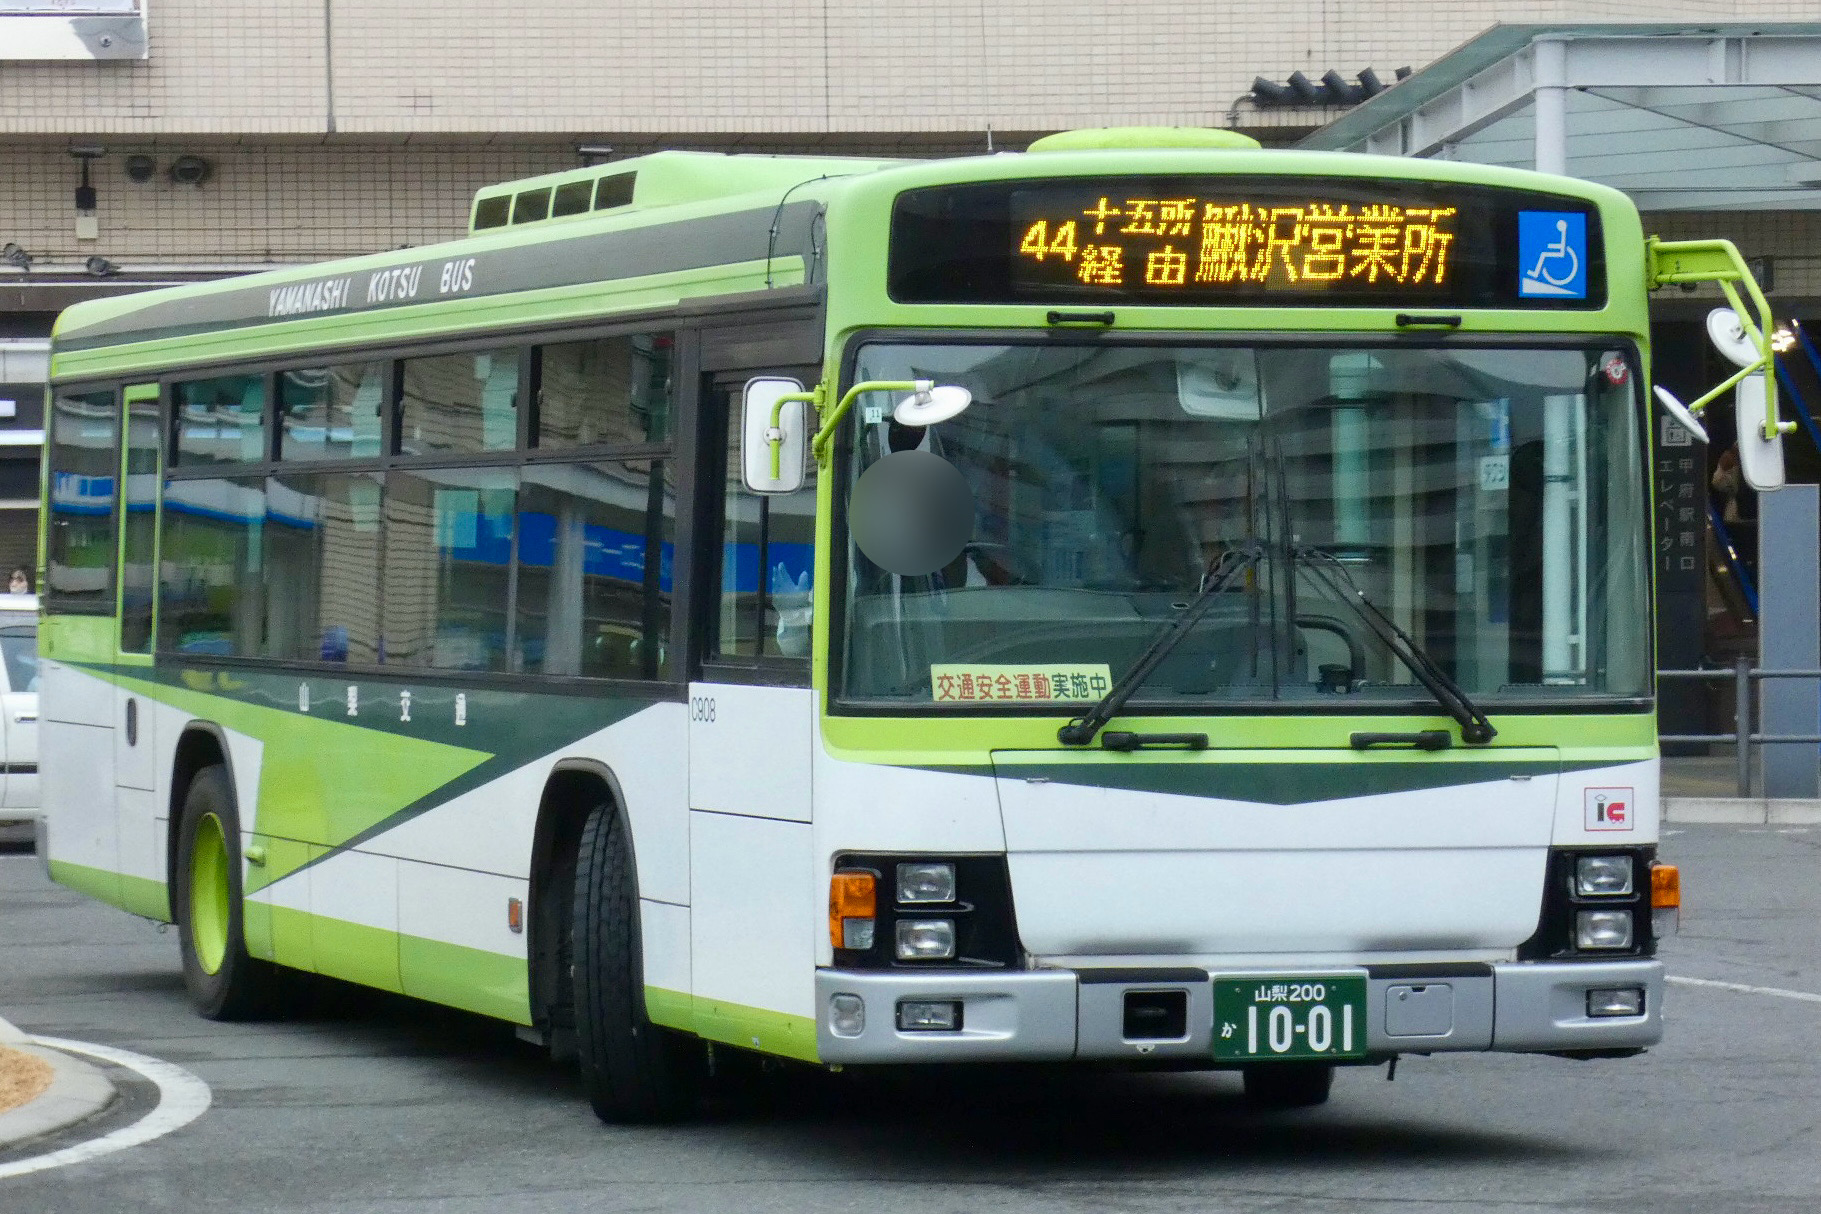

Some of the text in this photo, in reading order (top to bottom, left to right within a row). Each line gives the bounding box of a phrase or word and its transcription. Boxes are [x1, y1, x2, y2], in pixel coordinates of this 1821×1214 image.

[1083, 197, 1197, 236] 十五所
[1020, 220, 1078, 262] 44
[1195, 203, 1458, 283] 鰍沢営業所
[1077, 244, 1187, 285] 経由
[268, 258, 476, 317] YAMANASHI KOTSU BUS
[1679, 458, 1695, 571] 甲府駅南口
[937, 672, 1107, 700] 交通安全運動実施中
[692, 696, 716, 723] C908
[1221, 1004, 1352, 1053] か 10-01
